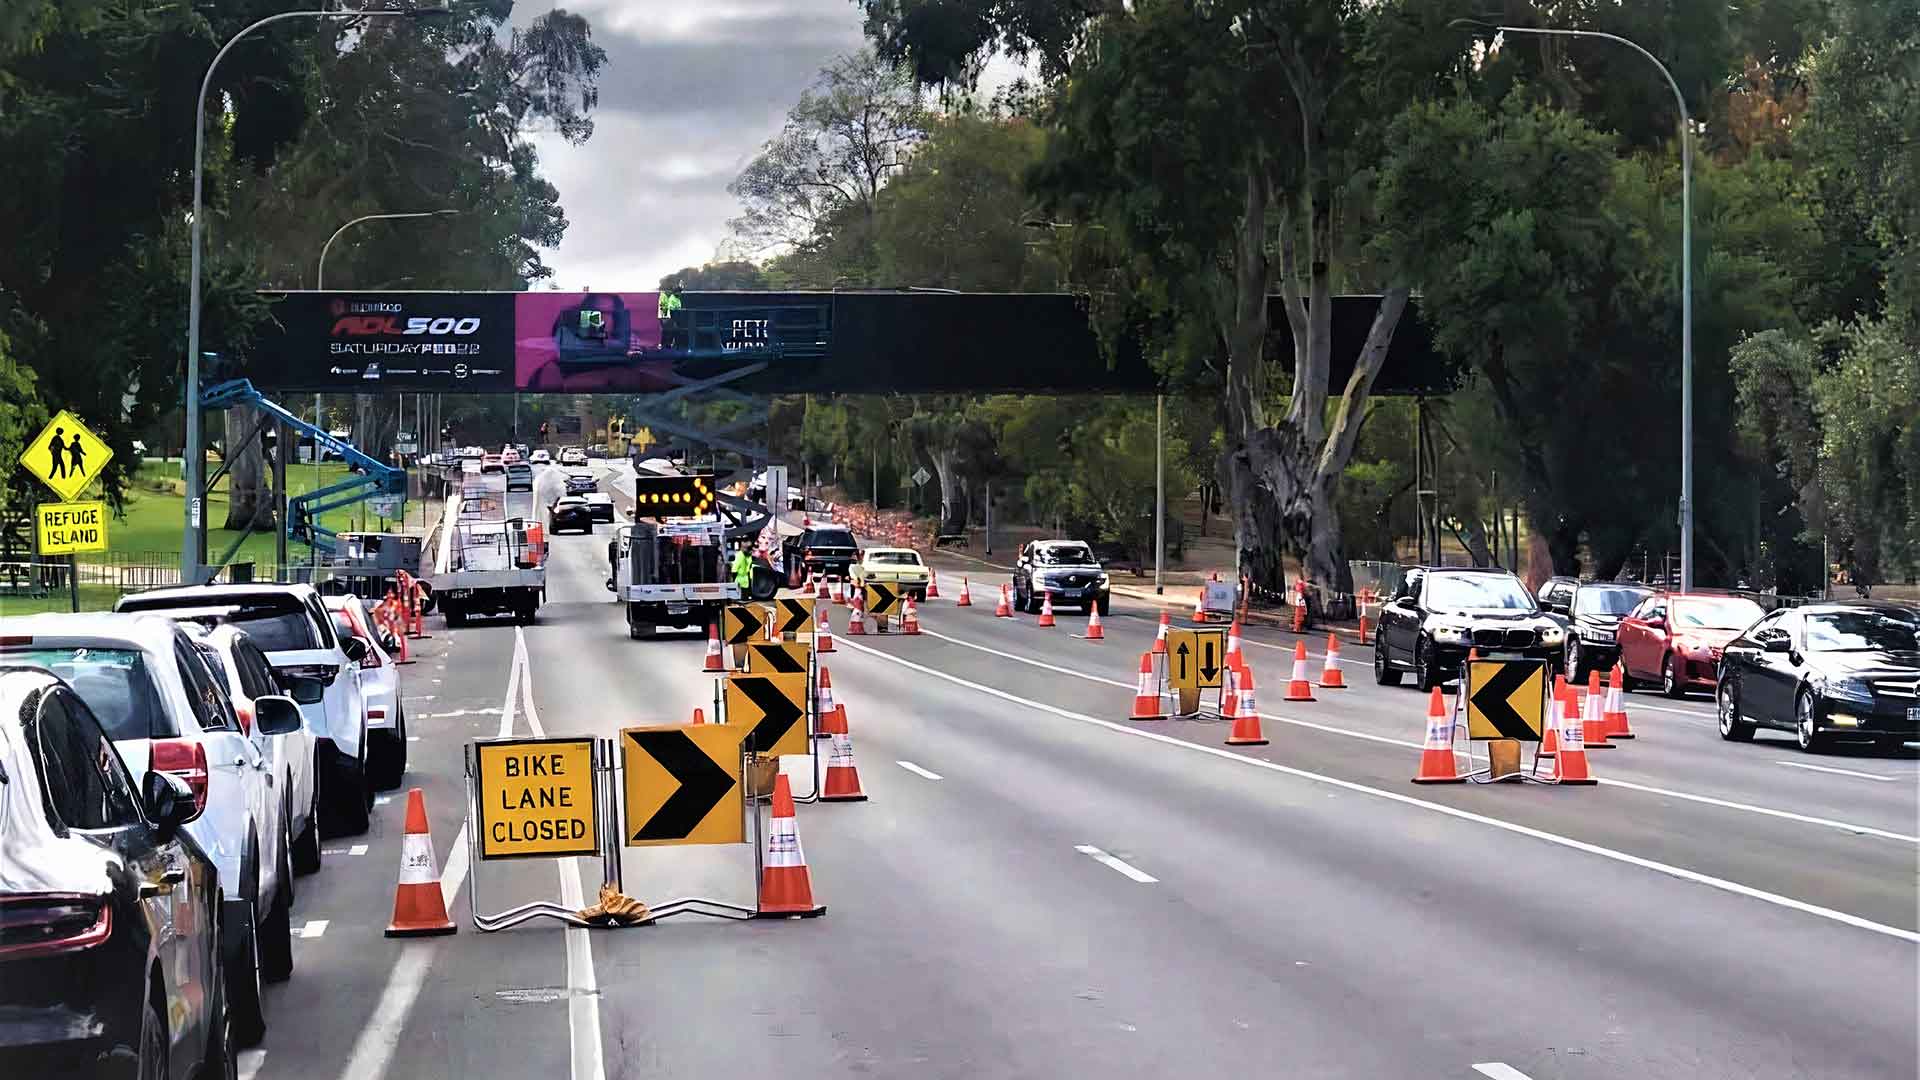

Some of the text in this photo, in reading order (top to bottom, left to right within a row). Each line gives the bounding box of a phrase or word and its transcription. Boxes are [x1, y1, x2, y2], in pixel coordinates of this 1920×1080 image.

[45, 509, 98, 526] REFUGE
[47, 529, 98, 545] ISLAND
[505, 754, 565, 777] BIKE
[502, 786, 573, 810] LANE
[492, 818, 586, 843] CLOSED
